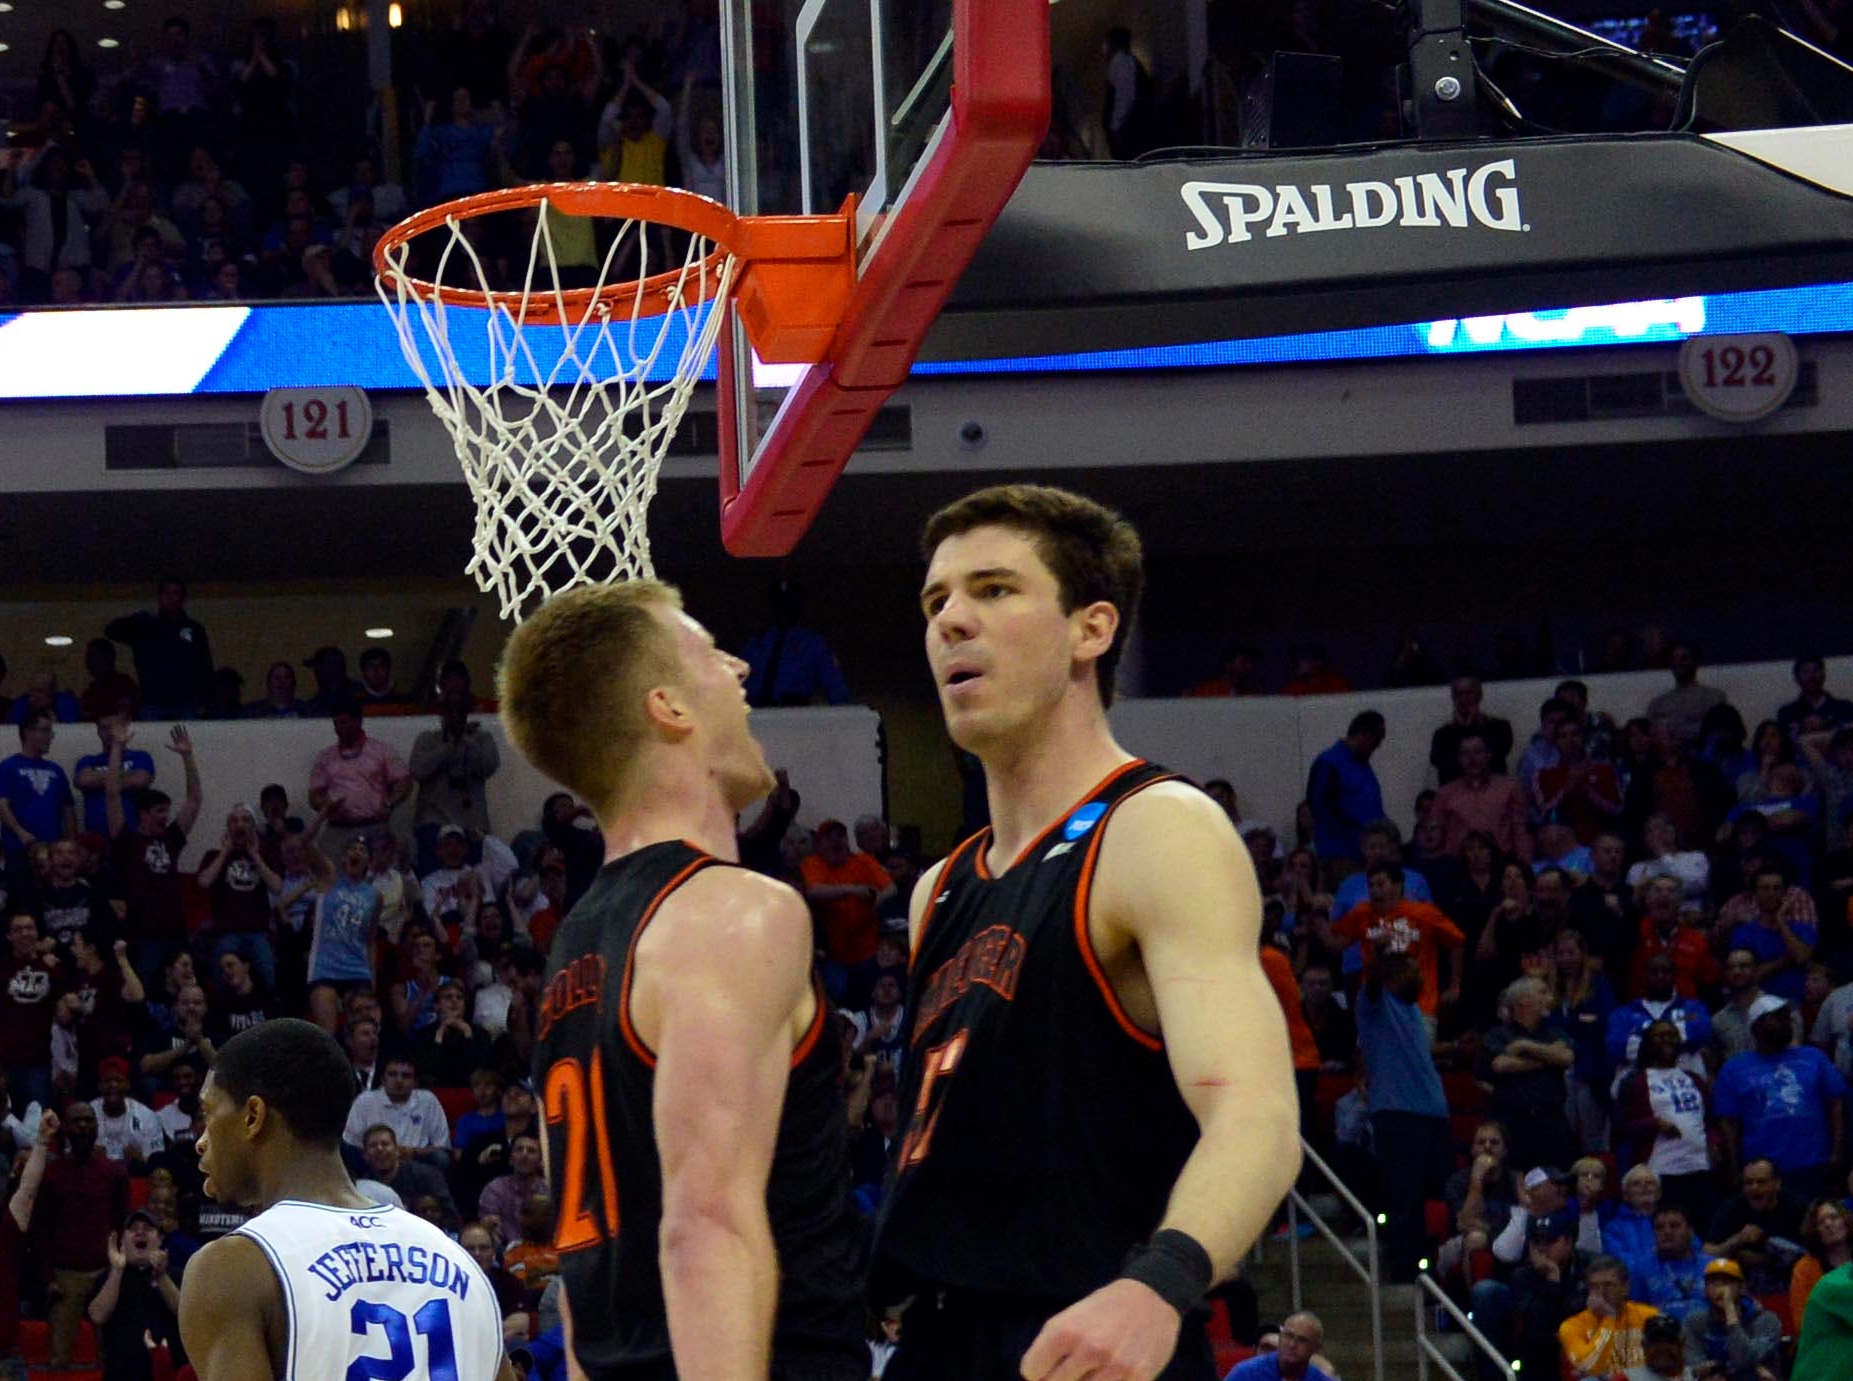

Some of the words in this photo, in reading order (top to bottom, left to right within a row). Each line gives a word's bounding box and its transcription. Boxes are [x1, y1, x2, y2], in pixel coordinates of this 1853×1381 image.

[1180, 158, 1522, 251] SPALDING
[1702, 344, 1776, 388] 122
[281, 398, 352, 441] 121
[350, 1214, 383, 1230] ACC
[306, 1241, 471, 1302] JEFFERSON
